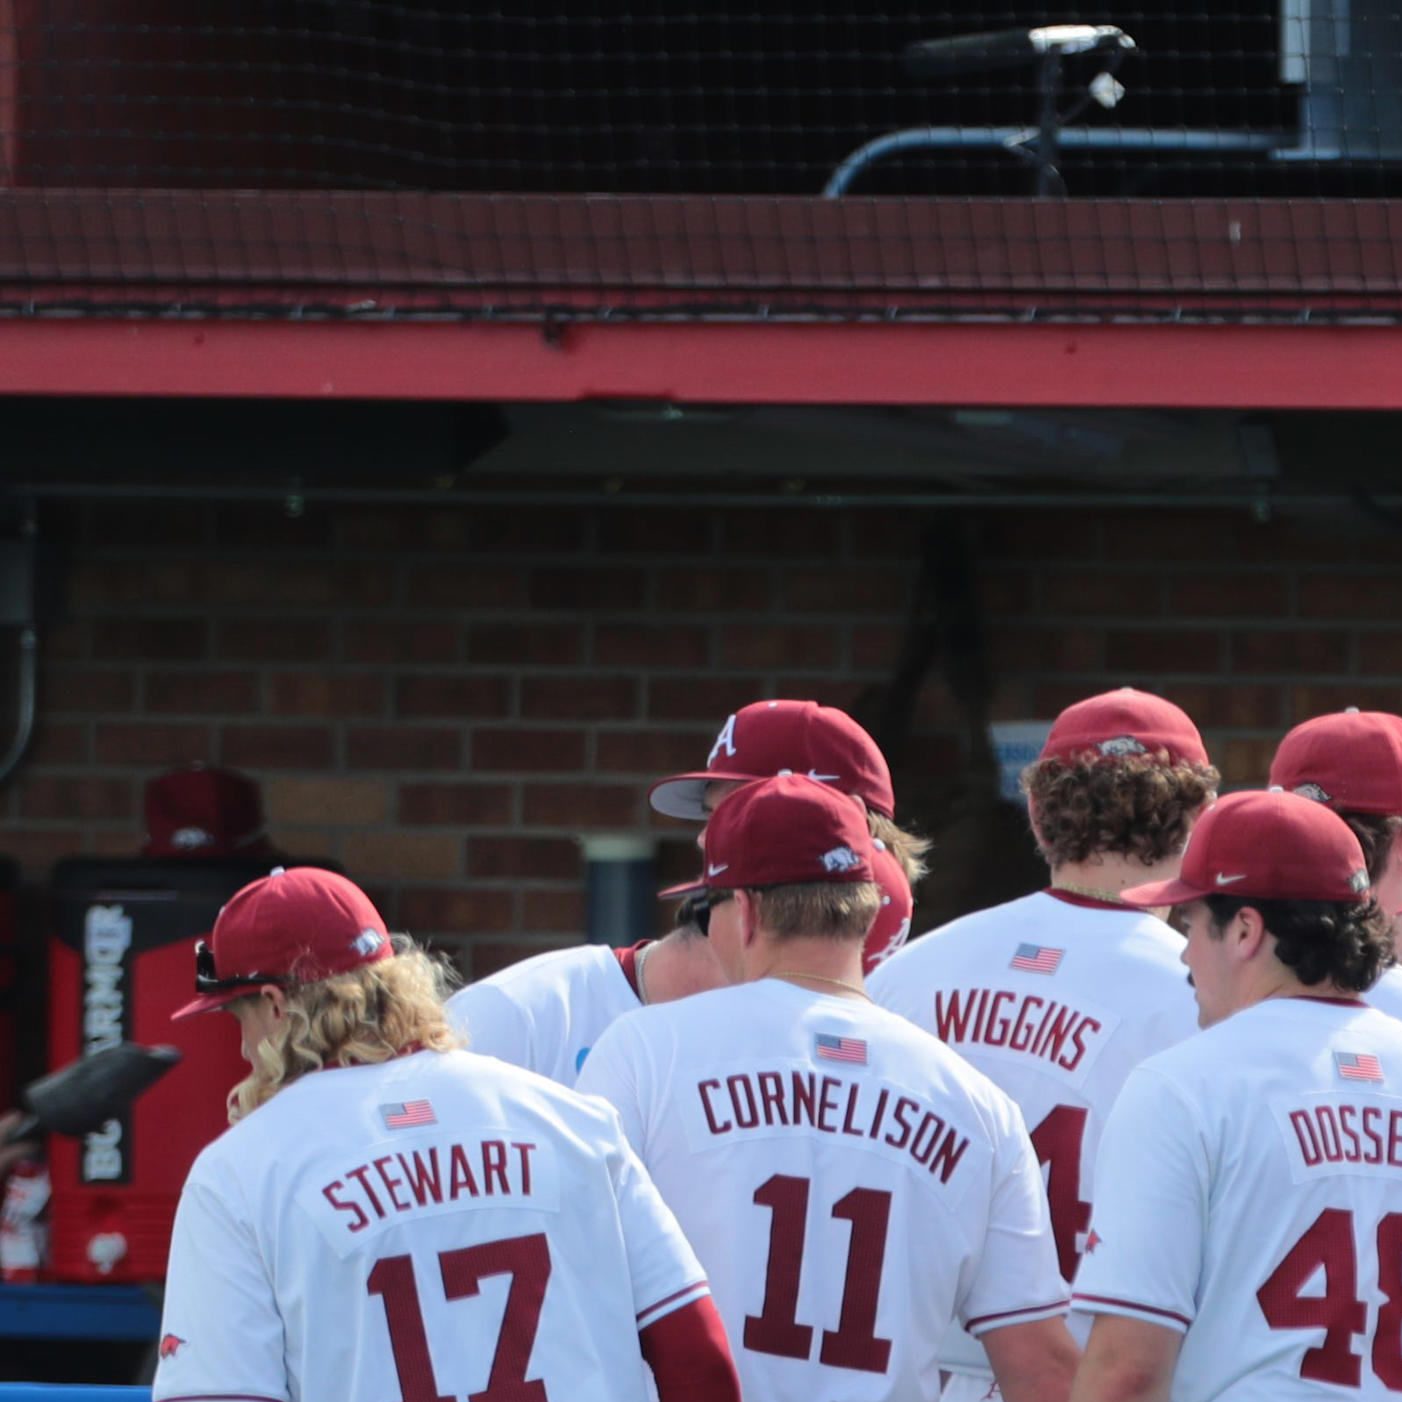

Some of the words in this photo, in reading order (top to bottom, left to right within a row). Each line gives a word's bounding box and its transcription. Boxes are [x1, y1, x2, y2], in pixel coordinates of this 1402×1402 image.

[706, 714, 736, 768] A
[935, 990, 1102, 1072] WIGGINS
[697, 1070, 971, 1185] CORNELISON
[321, 1140, 537, 1233] STEWART
[743, 1173, 893, 1375] 11
